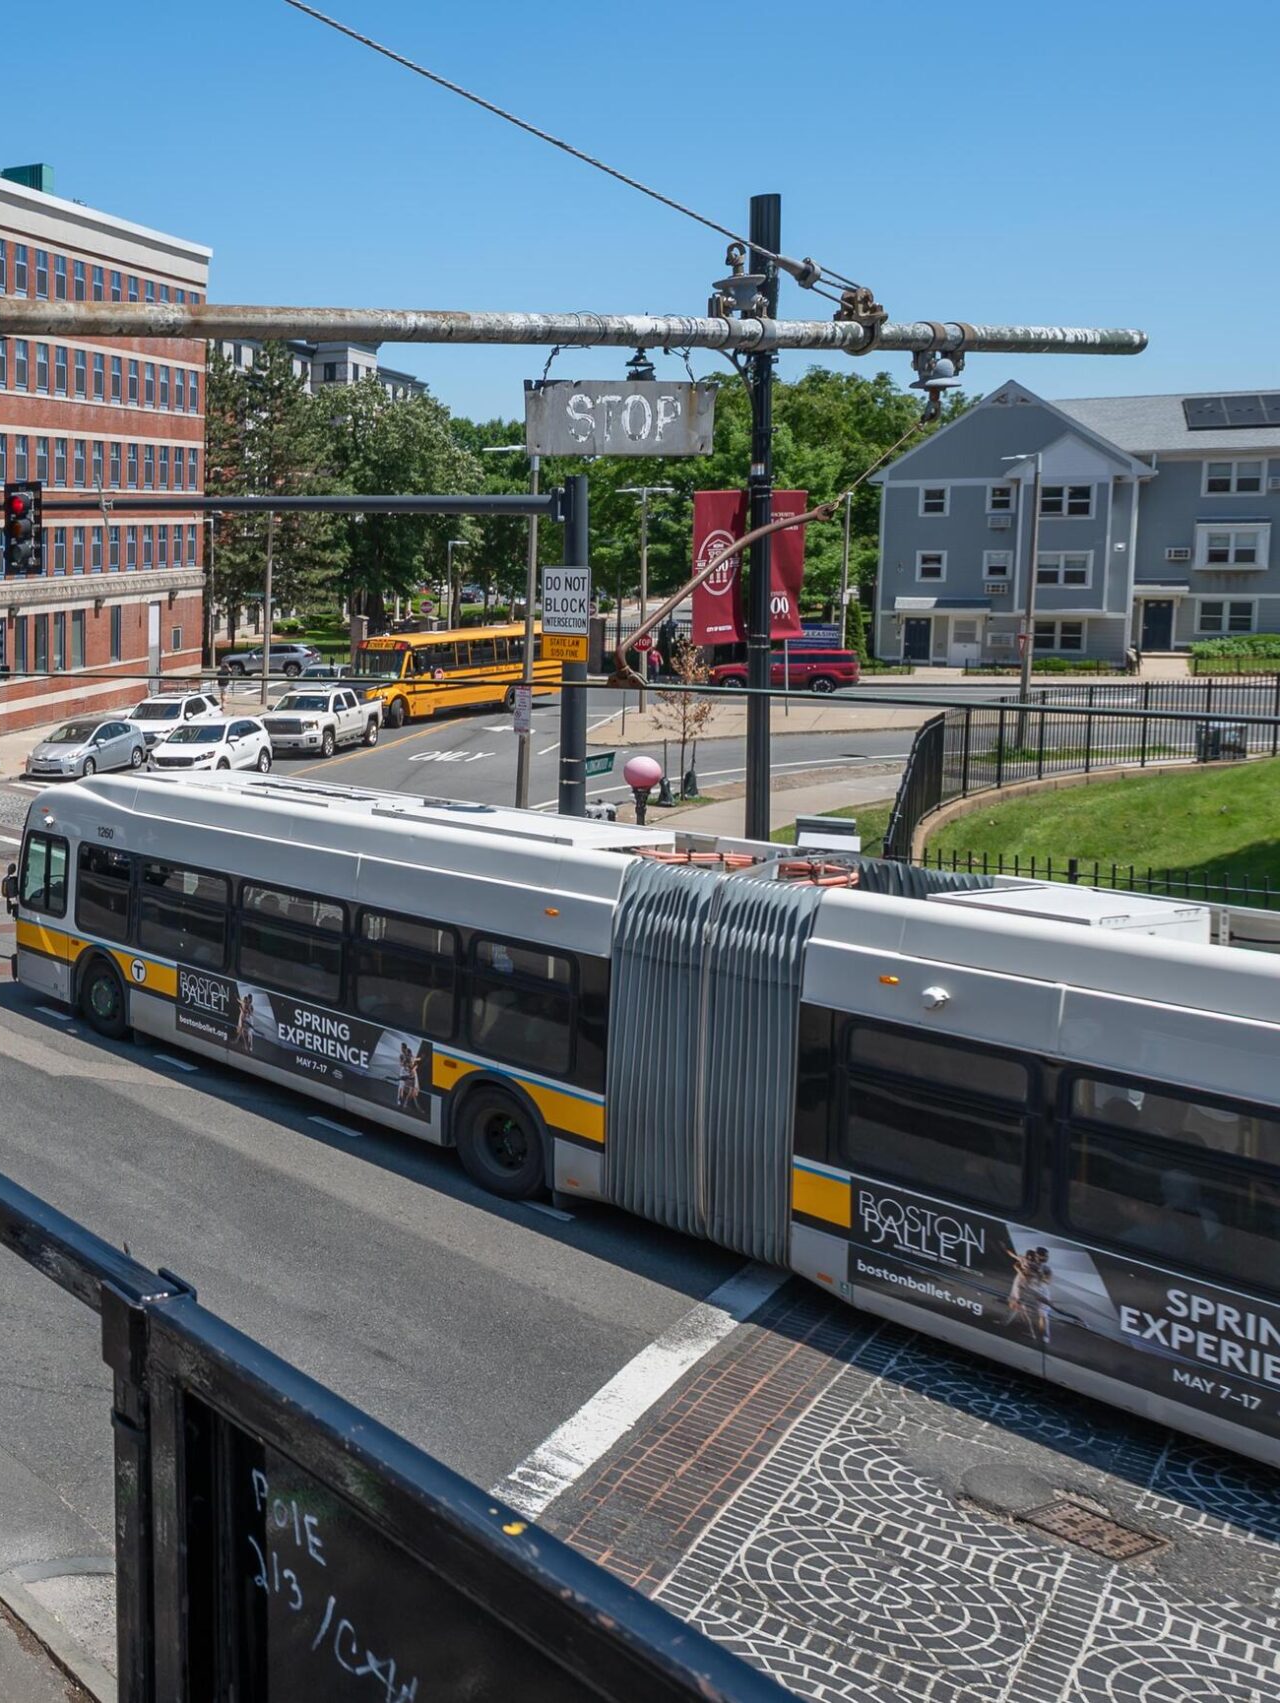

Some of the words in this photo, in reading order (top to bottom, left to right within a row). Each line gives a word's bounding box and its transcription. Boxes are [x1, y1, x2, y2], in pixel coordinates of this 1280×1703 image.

[566, 394, 681, 442] STOP
[546, 576, 561, 591] DO
[565, 576, 587, 591] NOT
[545, 598, 586, 613] BLOCK
[544, 617, 587, 628] INTERSECTION
[550, 638, 567, 647] STATE
[568, 639, 579, 647] LAW
[408, 751, 496, 762] ONLY
[98, 826, 114, 839] 1260
[133, 963, 144, 980] T
[180, 971, 230, 1003] BOSTON
[181, 981, 228, 1011] BALLET
[179, 1014, 228, 1041] bostonballet.org
[294, 1009, 350, 1041] SPRING
[278, 1022, 369, 1069] EXPERIENCE
[296, 1056, 312, 1068] MAY
[859, 1190, 985, 1254] BOSTON
[864, 1207, 979, 1267] BALLET
[857, 1259, 983, 1317] bostonballet.org
[1172, 1368, 1216, 1394] MAY
